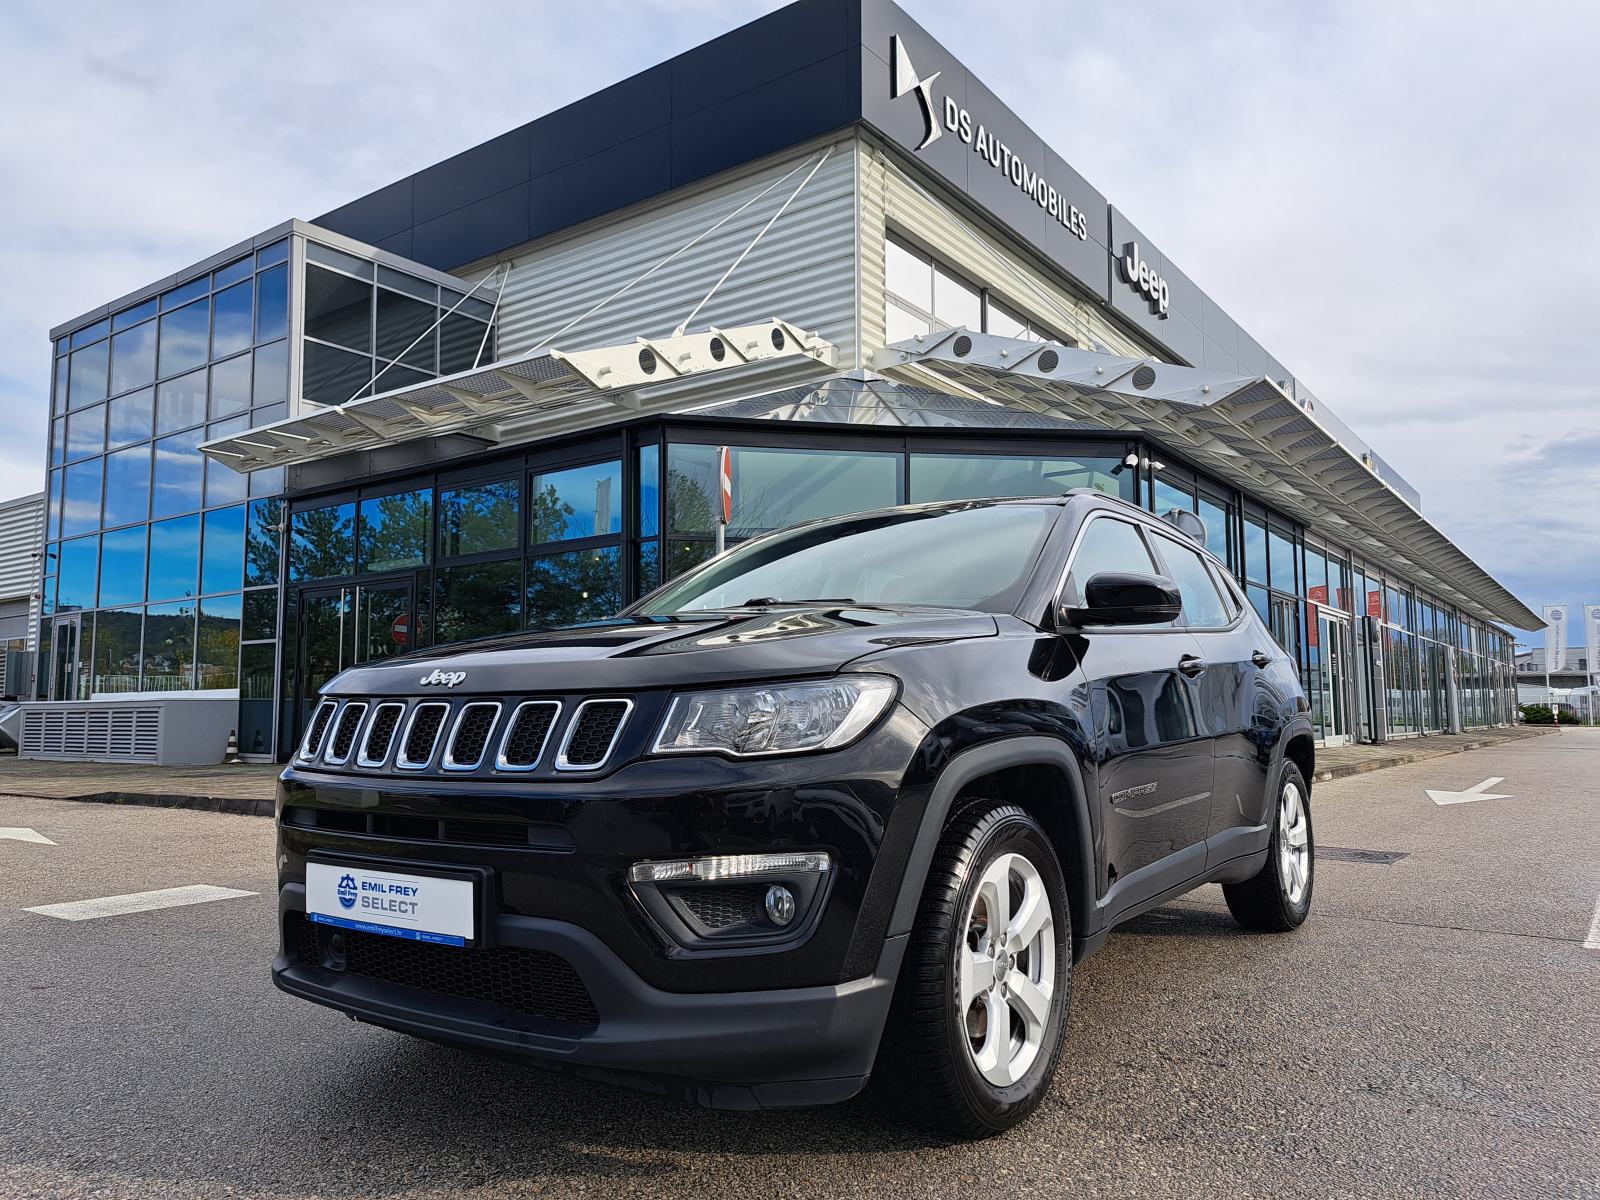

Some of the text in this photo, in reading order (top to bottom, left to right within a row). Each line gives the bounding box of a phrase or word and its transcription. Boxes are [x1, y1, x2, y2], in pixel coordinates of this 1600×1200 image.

[944, 96, 1088, 241] DS AUTOMOBILES
[1119, 241, 1169, 314] Jeep
[420, 668, 467, 688] Jeep
[361, 881, 418, 897] EMIL FREY
[361, 895, 418, 915] SELECT
